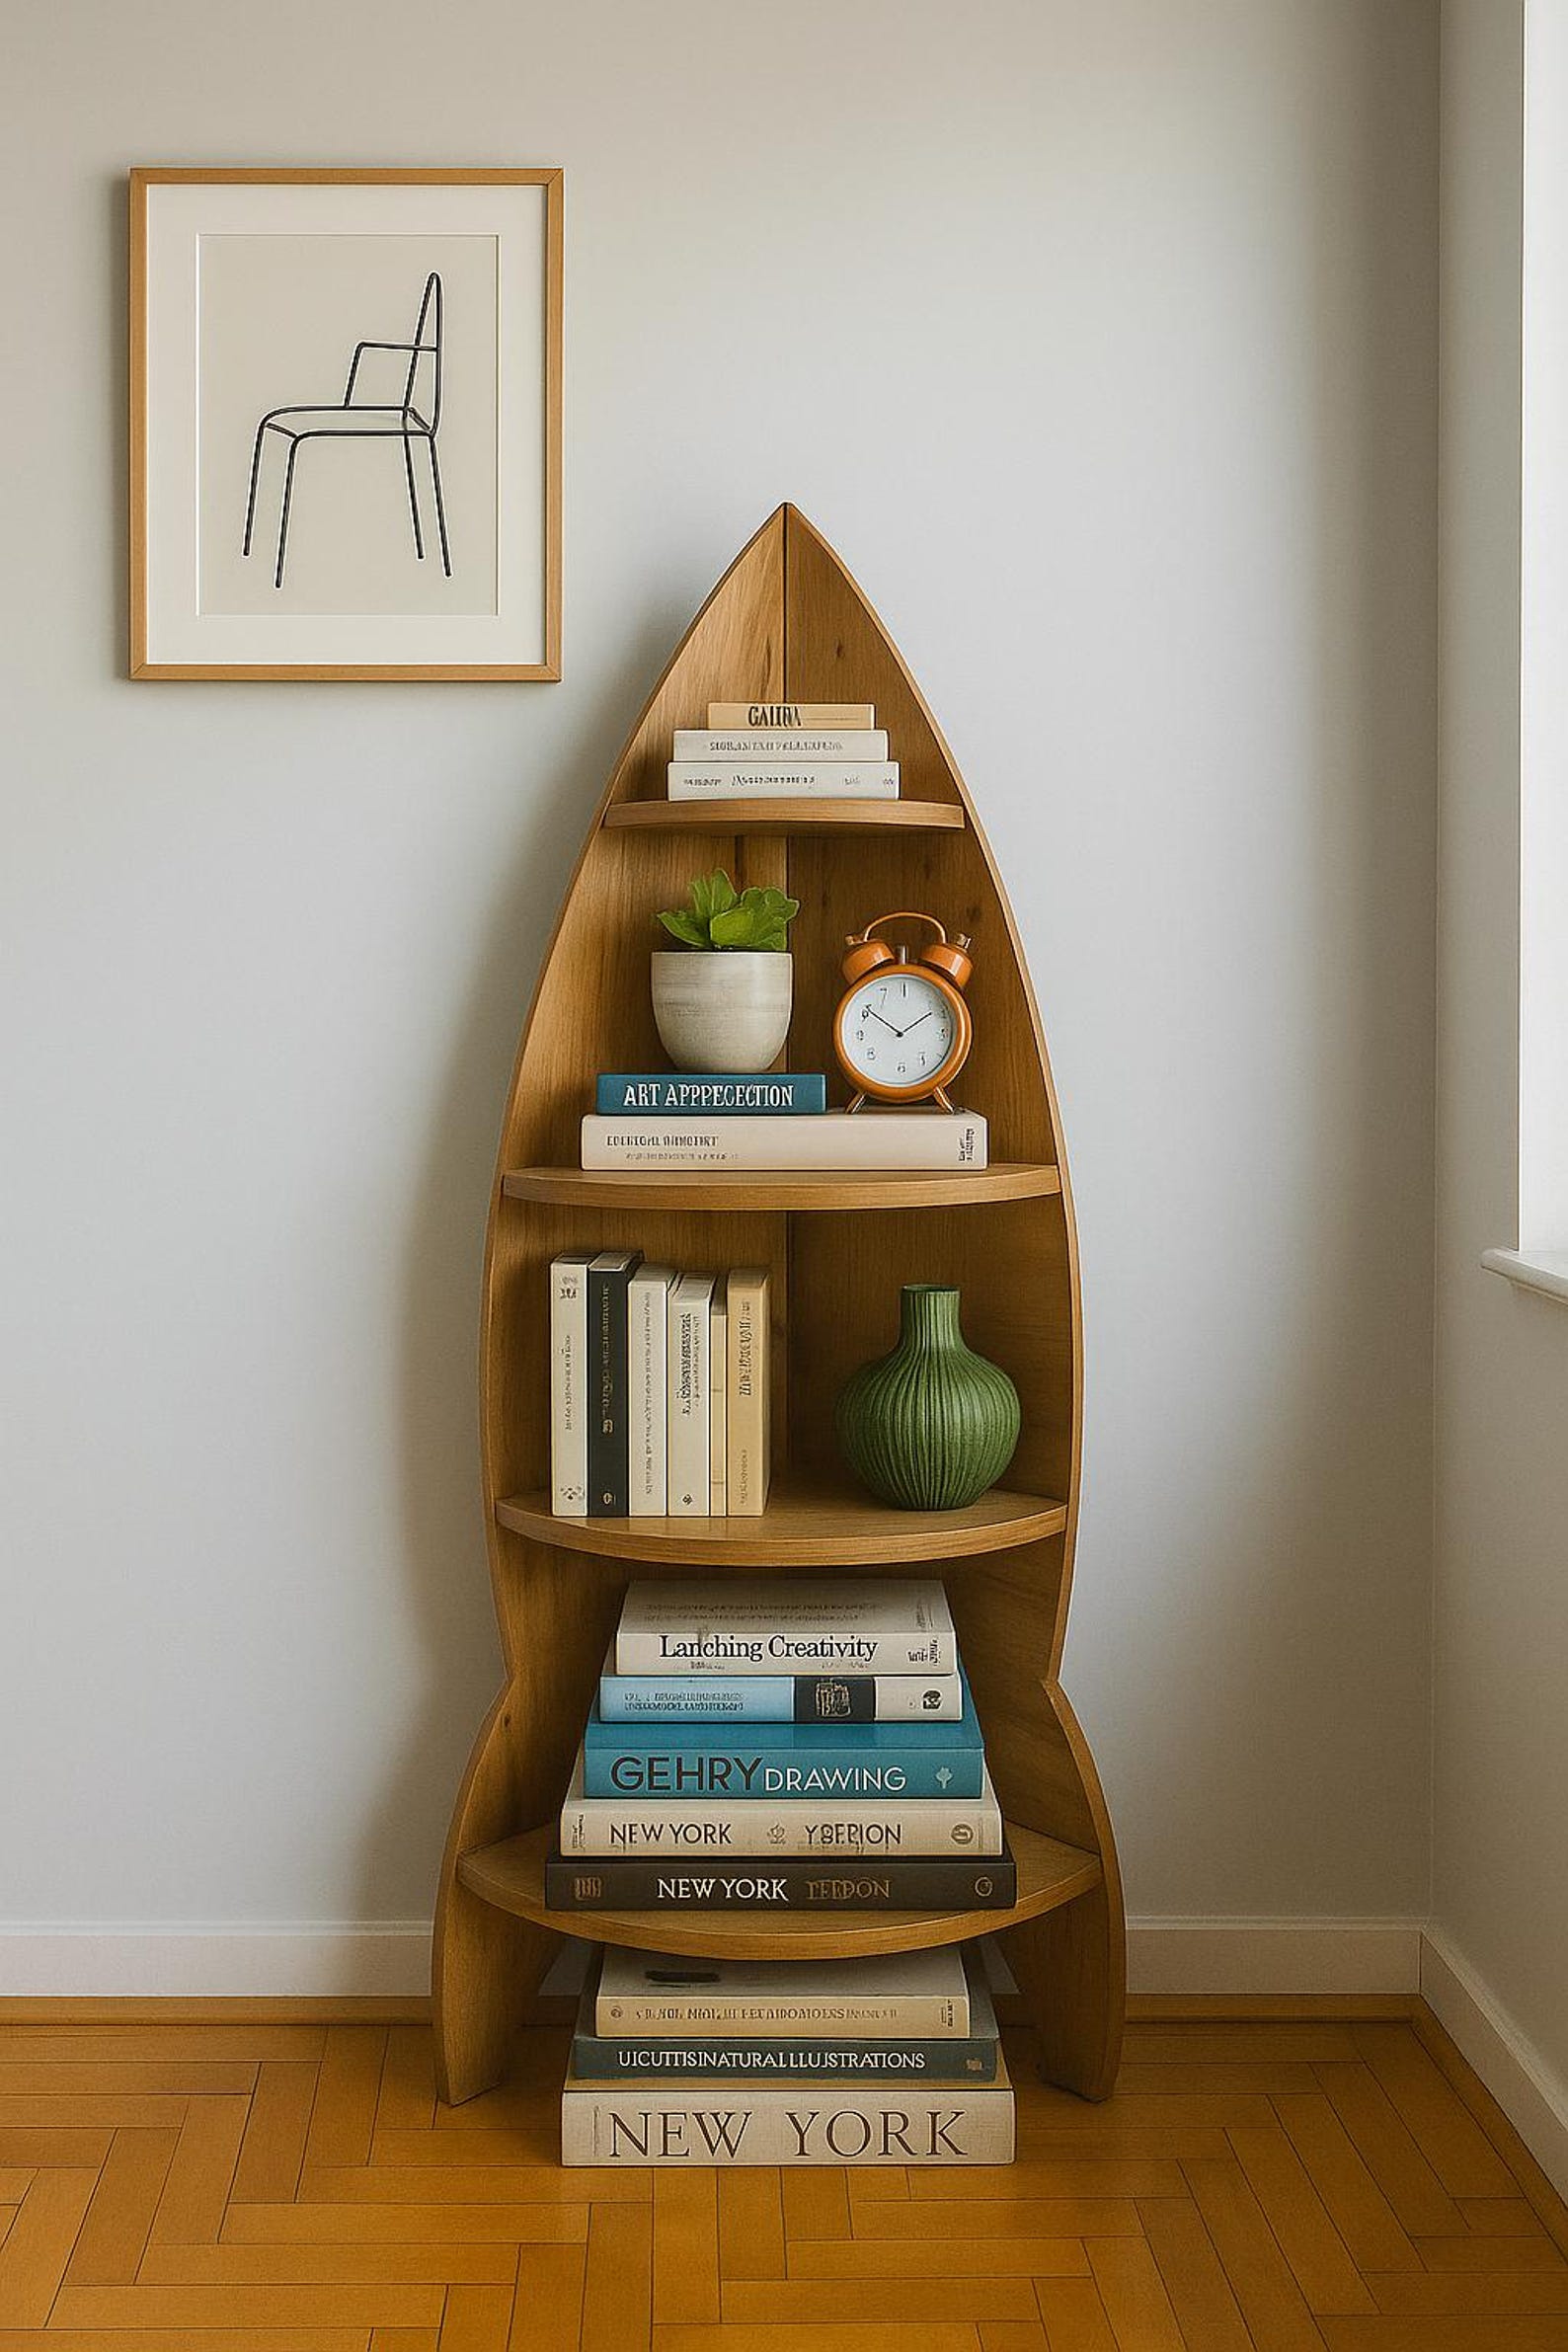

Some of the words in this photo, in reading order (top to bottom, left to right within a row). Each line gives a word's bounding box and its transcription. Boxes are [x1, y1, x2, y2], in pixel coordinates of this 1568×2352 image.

[623, 1083, 661, 1107] ART
[659, 1635, 763, 1662] Lanching
[768, 1635, 879, 1662] Creativity
[610, 1756, 763, 1792] GEHRY
[764, 1766, 906, 1792] DRAWING
[610, 1823, 665, 1846] NEW
[667, 1823, 733, 1844] YORK
[657, 1878, 717, 1900] NEW
[718, 1878, 789, 1902] YORK
[608, 2110, 752, 2159] NEW
[784, 2109, 969, 2158] YORK
